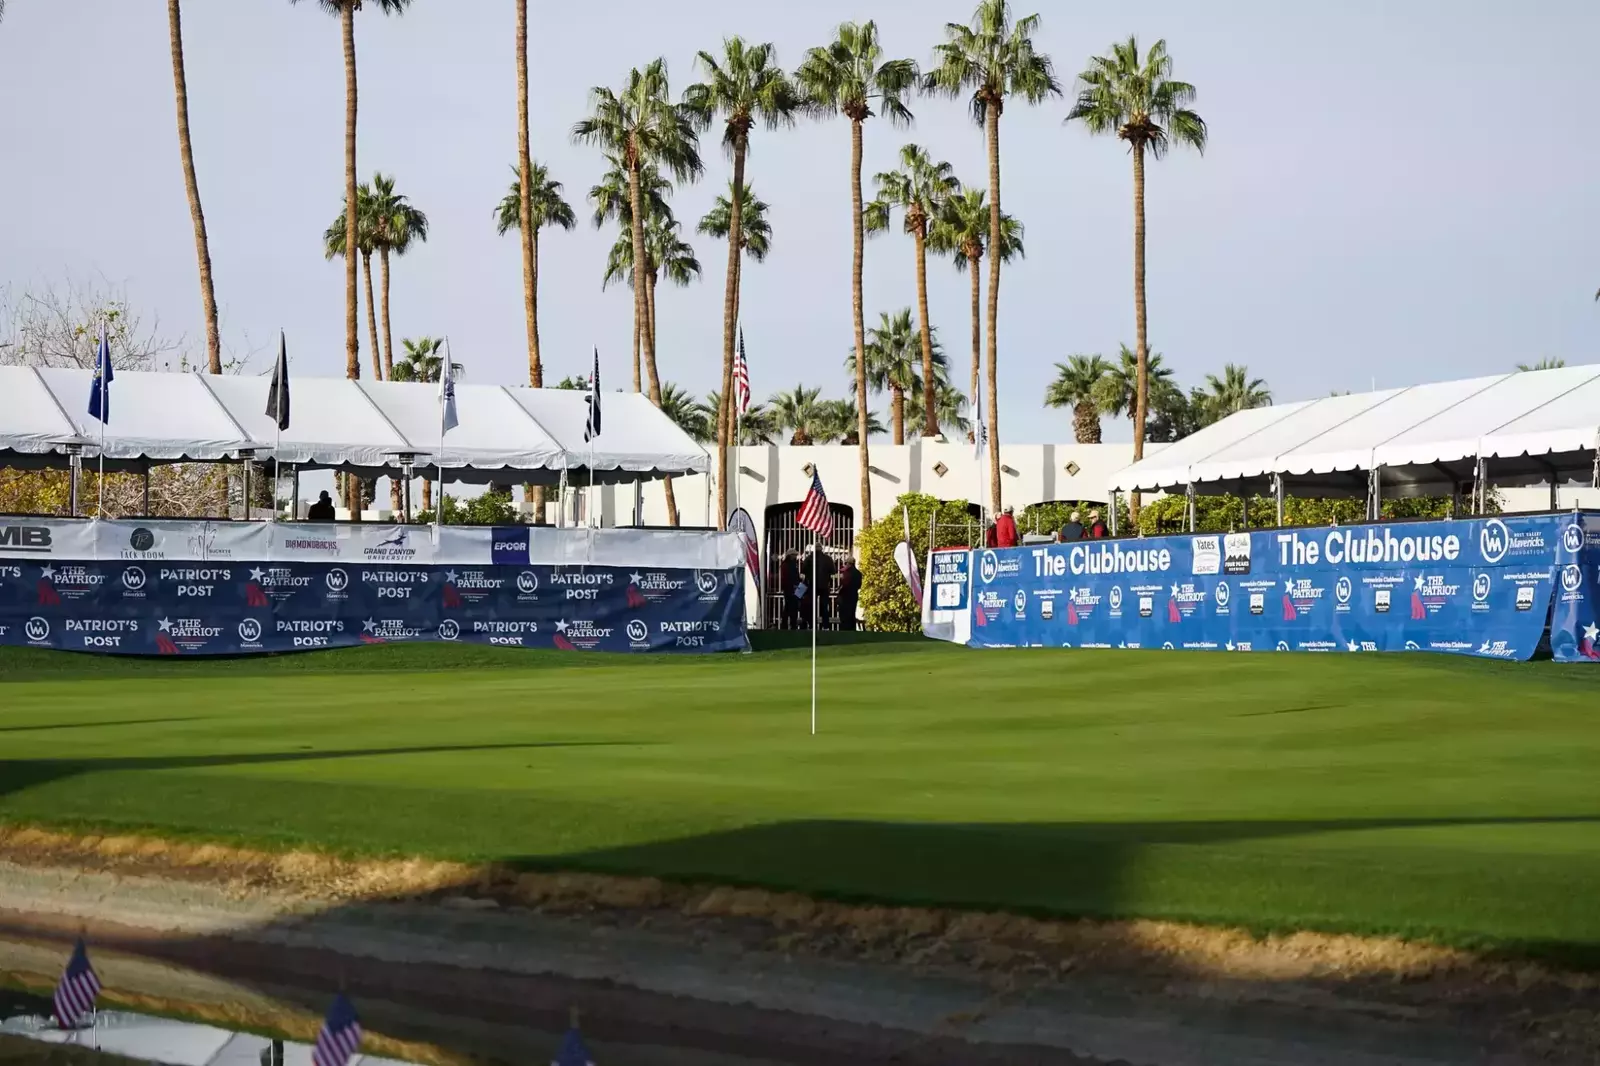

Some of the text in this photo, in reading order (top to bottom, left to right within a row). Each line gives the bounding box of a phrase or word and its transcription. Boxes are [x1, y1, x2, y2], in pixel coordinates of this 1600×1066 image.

[494, 542, 526, 551] EPCOR
[1196, 539, 1215, 550] Yates
[1277, 528, 1460, 565] The Clubhouse
[1509, 538, 1544, 549] Mavericks
[120, 551, 164, 559] TACK ROOM
[934, 553, 964, 564] THANK YOU
[1032, 543, 1171, 577] The Clubhouse
[60, 566, 86, 575] THE
[939, 563, 958, 573] TO OUR
[160, 569, 231, 580] PATRIOT'S
[268, 569, 291, 577] THE
[362, 571, 428, 582] PATRIOT'S
[463, 571, 484, 580] THE
[646, 573, 667, 581] THE
[932, 572, 967, 583] ANNOUNCERS
[54, 575, 105, 584] PATRIOT
[262, 577, 310, 586] PATRIOT
[550, 574, 614, 584] PATRIOT'S
[1427, 576, 1443, 585] THE
[457, 580, 502, 588] PATRIOT
[641, 581, 683, 589] PATRIOT
[1181, 584, 1194, 592] THE
[1297, 580, 1311, 588] THE
[177, 586, 214, 597] POST
[378, 588, 411, 598] POST
[566, 589, 599, 599] POST
[1079, 588, 1090, 596] THE
[1292, 588, 1324, 598] PATRIOT
[1422, 585, 1457, 595] PATRIOT
[986, 591, 998, 600] THE
[1177, 592, 1206, 602] PATRIOT
[984, 600, 1007, 608] PATRIOT
[1076, 596, 1101, 605] PATRIOT
[65, 620, 138, 631] PATRIOT'S
[178, 619, 201, 628] THE
[276, 621, 344, 632] PATRIOT'S
[381, 620, 403, 628] THE
[474, 621, 537, 633] PATRIOT'S
[573, 620, 593, 629] THE
[660, 621, 720, 632] PATRIOT'S
[171, 628, 221, 637] PATRIOT
[375, 628, 421, 637] PATRIOT
[567, 628, 611, 637] PATRIOT
[84, 636, 121, 646] POST
[293, 636, 328, 646] POST
[490, 637, 523, 645] POST
[676, 636, 705, 646] POST
[1361, 641, 1377, 651] THE
